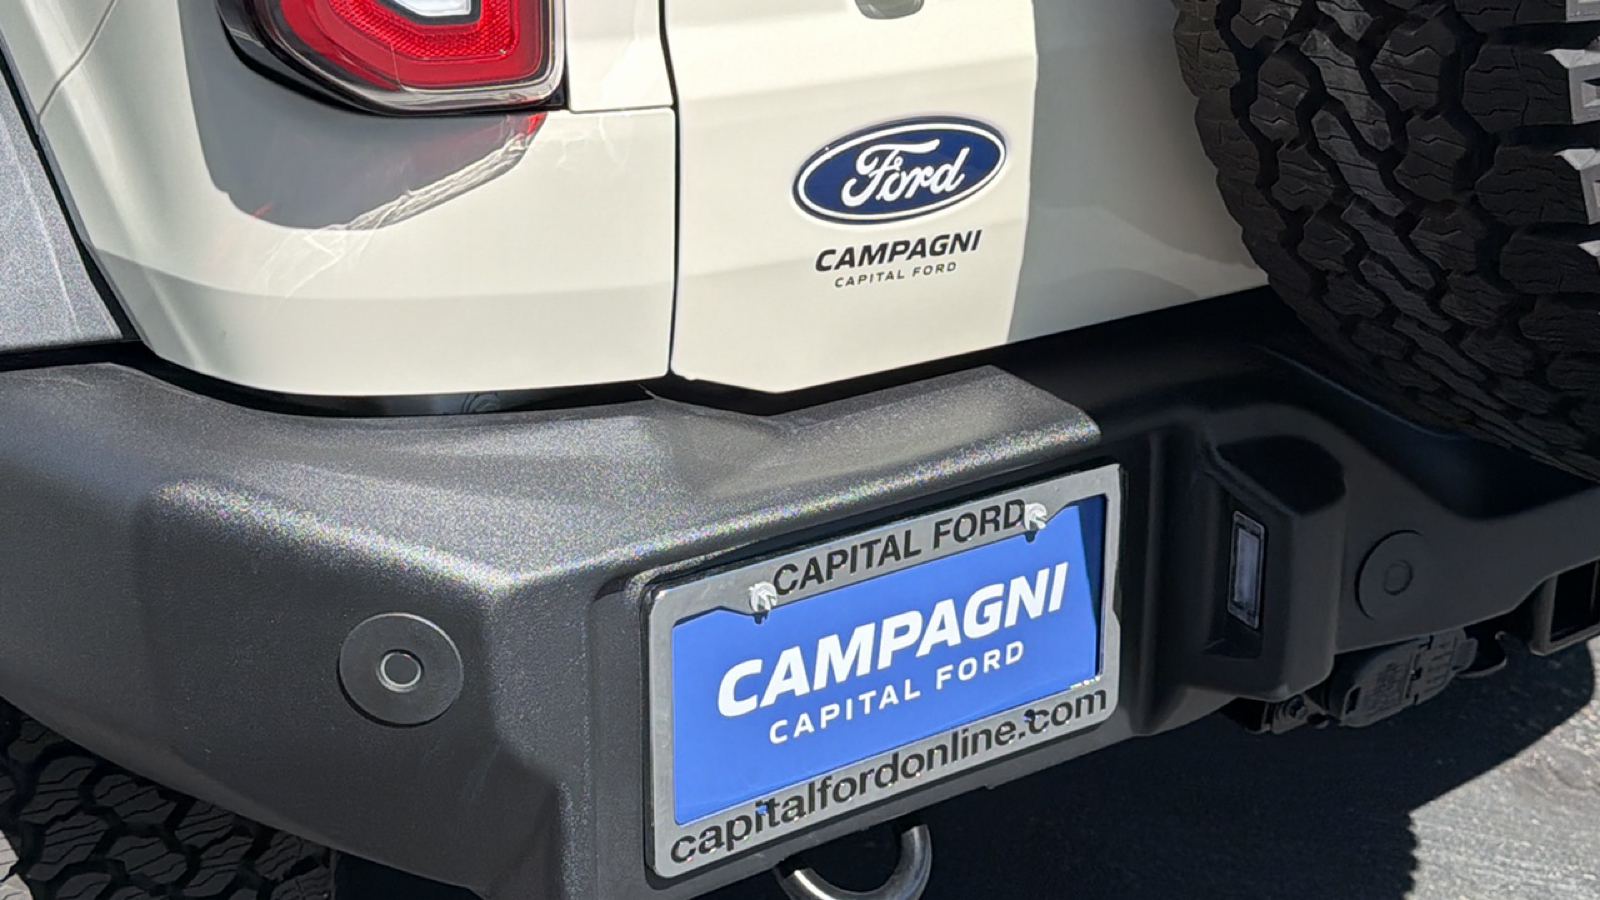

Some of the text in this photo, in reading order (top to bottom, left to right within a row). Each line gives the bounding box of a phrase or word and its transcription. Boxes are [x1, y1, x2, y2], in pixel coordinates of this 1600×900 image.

[841, 138, 970, 207] Ford
[815, 229, 982, 272] CAMPAGNI
[834, 261, 957, 288] CAPITAL FORD
[773, 498, 1026, 596] CAPITAL FORD
[717, 561, 1068, 717] CAMPAGNI
[769, 640, 1025, 745] CAPITAL FORD
[670, 689, 1107, 864] capitalfordonline.com
